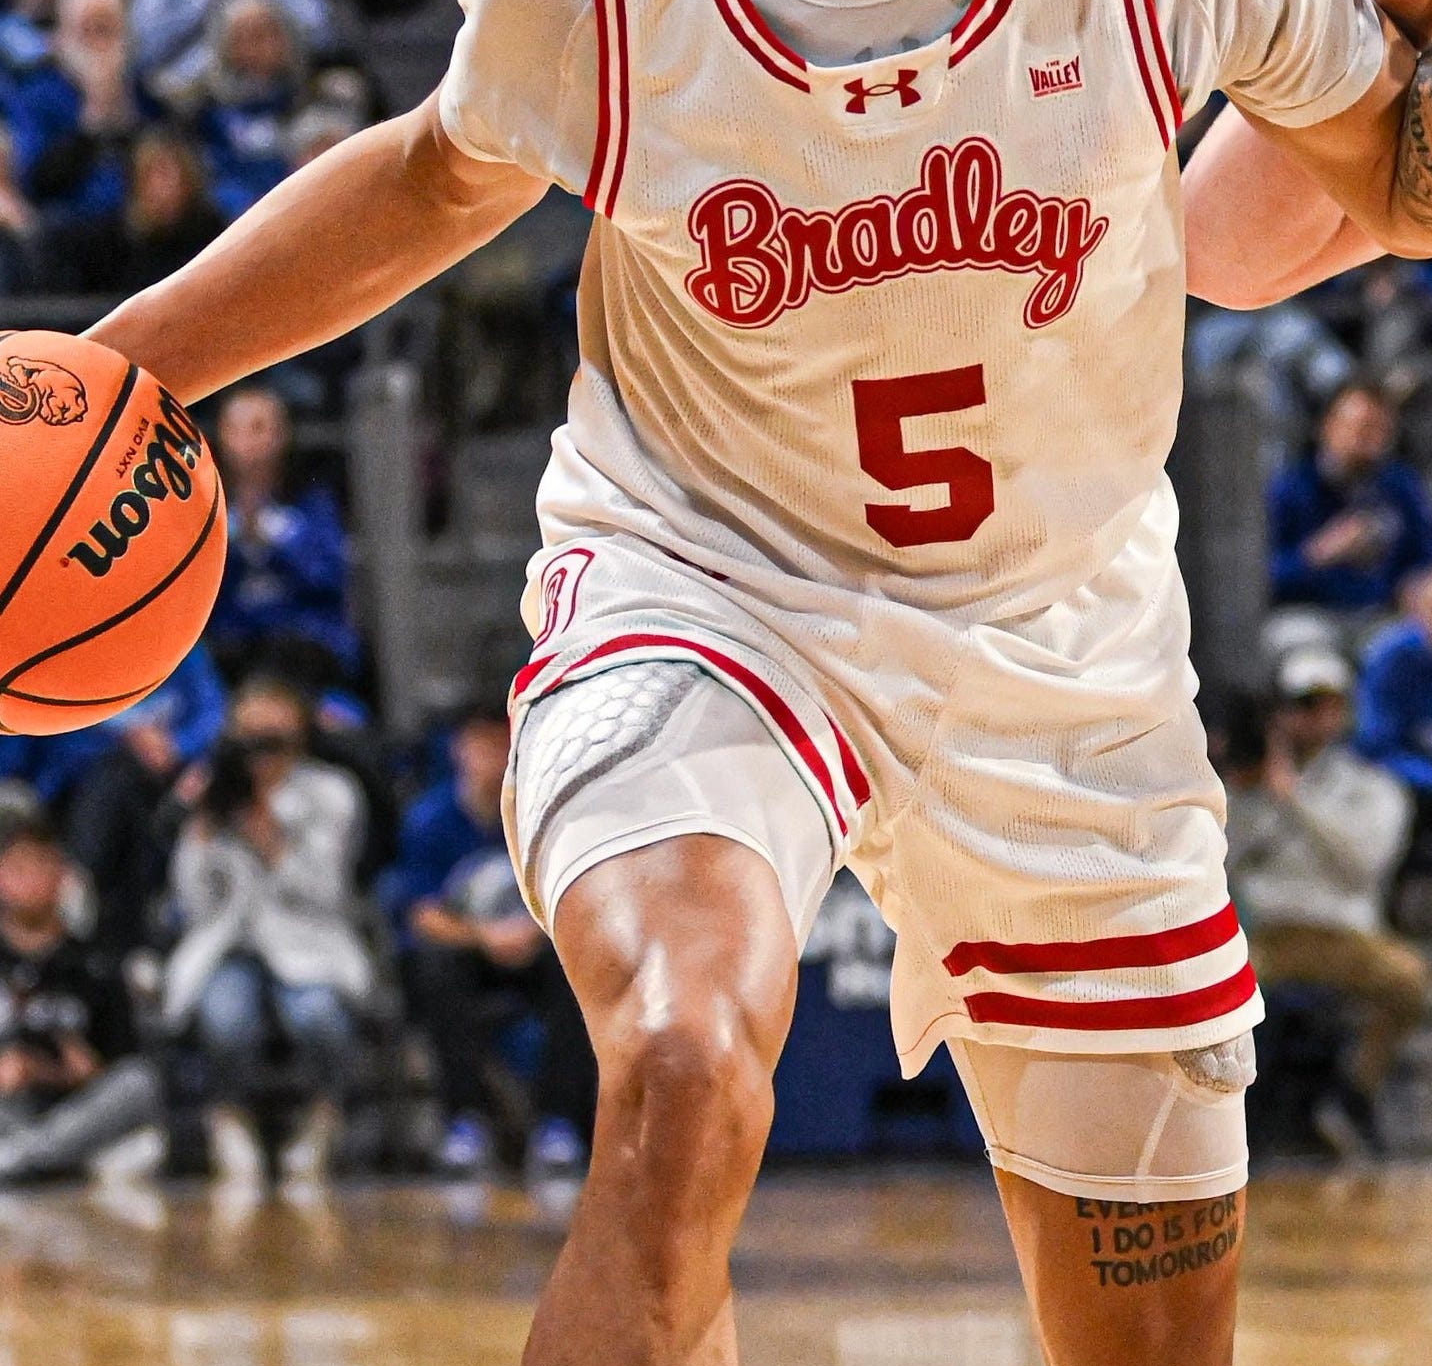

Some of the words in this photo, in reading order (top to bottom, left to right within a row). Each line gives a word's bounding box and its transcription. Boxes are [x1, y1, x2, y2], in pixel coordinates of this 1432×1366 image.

[1028, 55, 1081, 92] VALLEY
[684, 136, 1109, 330] Bradley
[133, 417, 150, 445] EVO
[852, 363, 995, 549] 5
[66, 385, 202, 578] Wilson
[115, 448, 137, 479] NXT
[1090, 1226, 1101, 1253] I
[1113, 1222, 1154, 1254] DO
[1162, 1215, 1185, 1241] IS
[1090, 1221, 1239, 1287] TOMORROW
